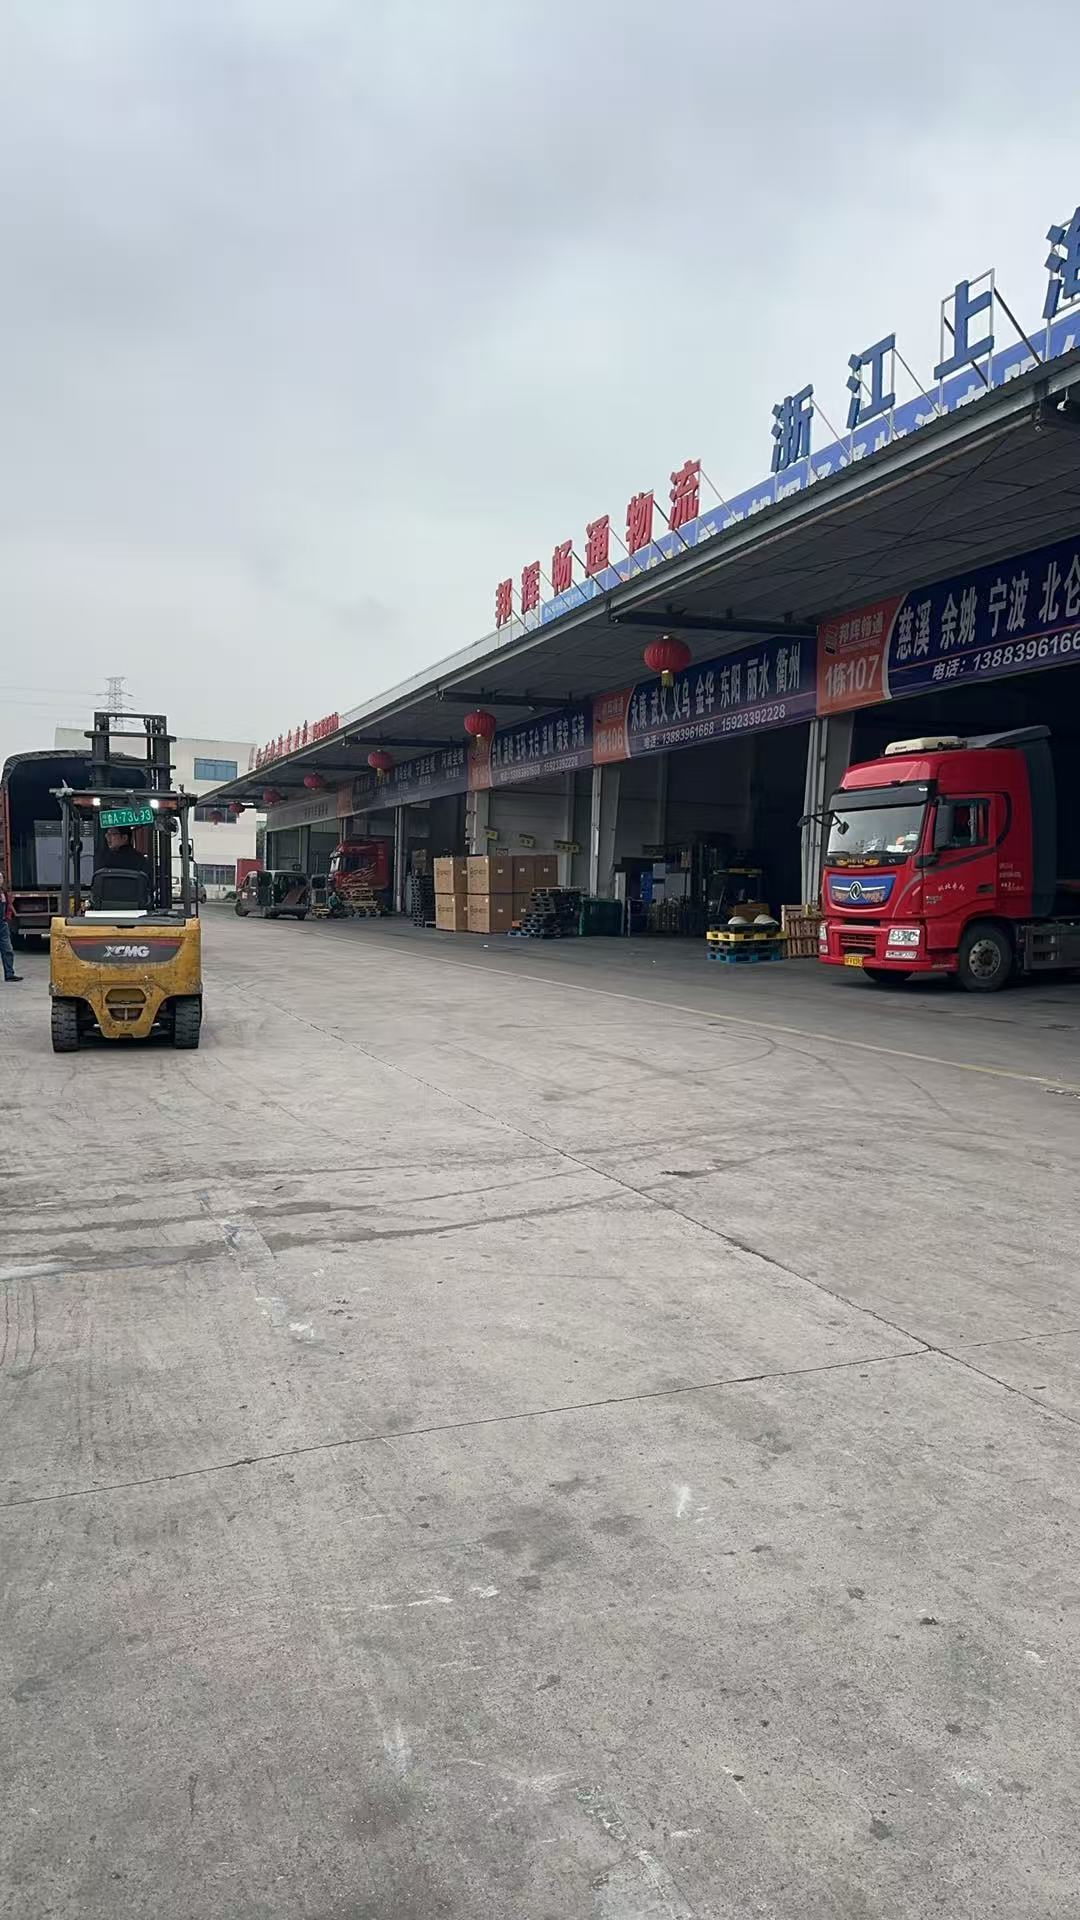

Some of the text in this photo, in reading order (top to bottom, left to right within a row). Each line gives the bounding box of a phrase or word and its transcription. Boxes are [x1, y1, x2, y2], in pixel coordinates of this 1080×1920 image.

[896, 554, 1080, 660] 慈溪 余姚 宁波 北仑
[650, 687, 669, 725] 武义
[672, 678, 691, 720] 义乌
[695, 670, 715, 714] 金华
[719, 663, 741, 708] 东阳
[747, 652, 770, 702] 丽水
[824, 653, 880, 698] 1栋107
[721, 703, 786, 732] 15923392228
[103, 945, 150, 958] XCMG
